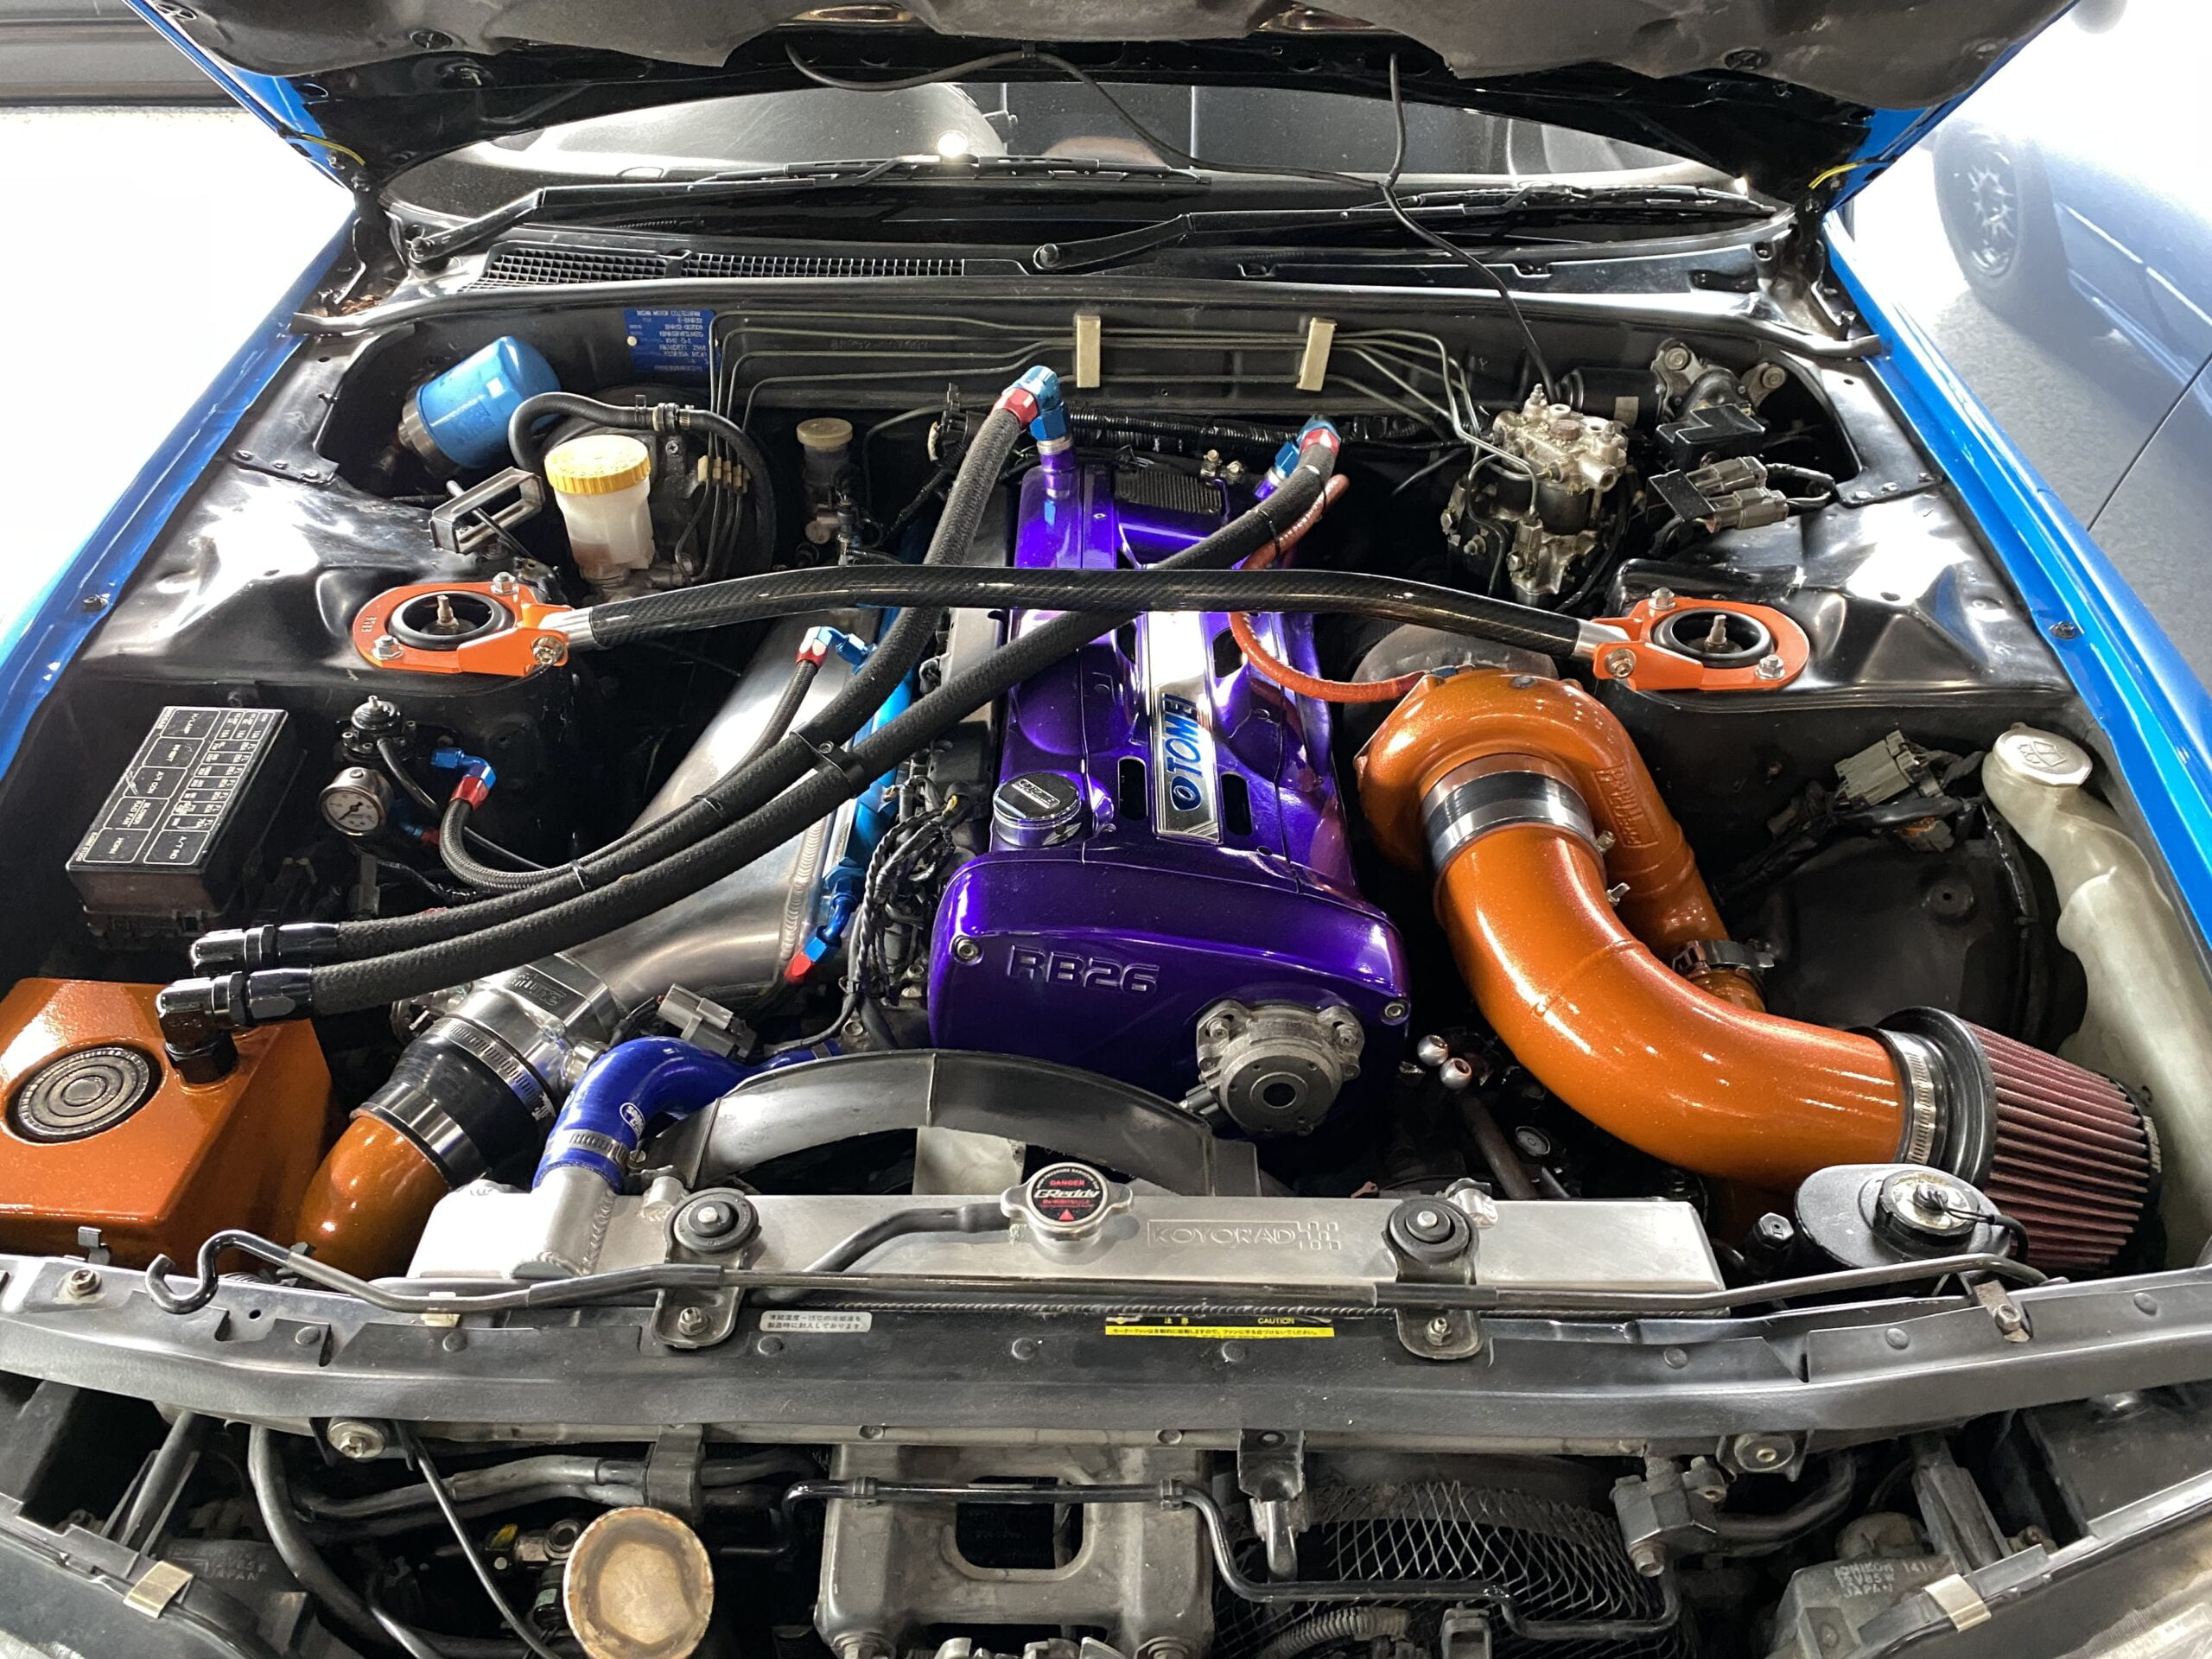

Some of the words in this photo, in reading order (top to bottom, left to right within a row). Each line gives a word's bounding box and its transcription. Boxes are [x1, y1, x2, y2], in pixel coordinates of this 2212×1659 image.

[1006, 944, 1160, 995] RB26
[1033, 1188, 1101, 1199] GReddy
[1153, 1227, 1296, 1245] KOYORAD
